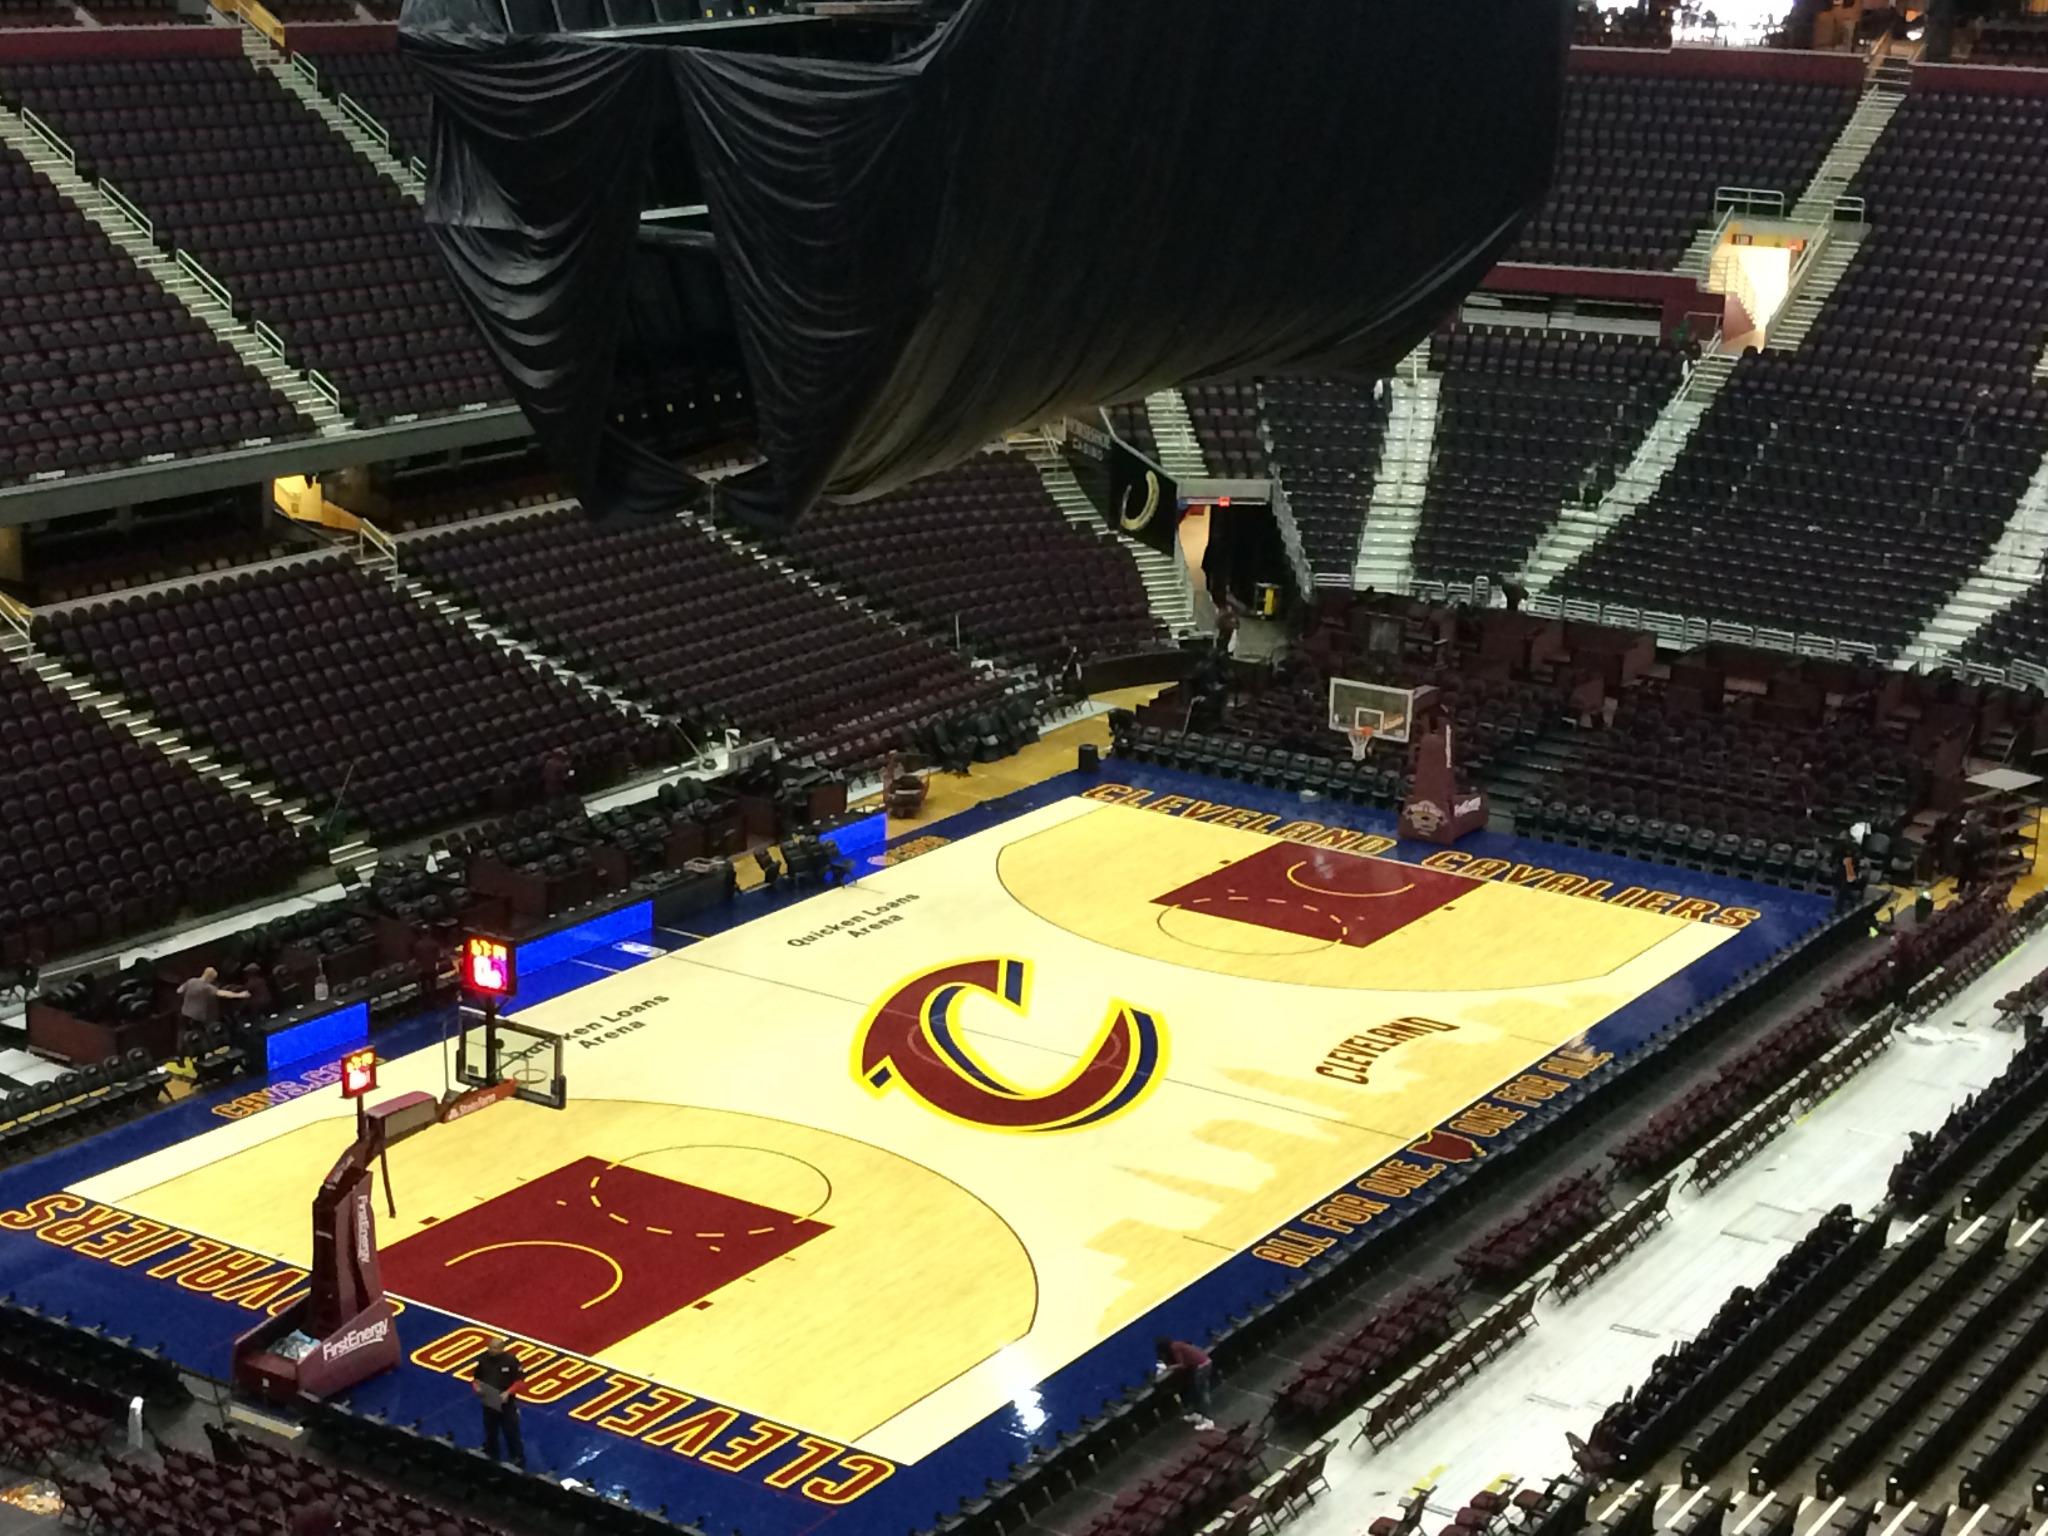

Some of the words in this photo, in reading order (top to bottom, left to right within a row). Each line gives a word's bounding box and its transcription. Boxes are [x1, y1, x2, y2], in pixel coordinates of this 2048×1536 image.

[1080, 783, 1397, 856] CLEVELAND
[1421, 850, 1761, 928] CAVALIERS
[787, 915, 866, 947] Quicken
[862, 893, 920, 916] Loans
[848, 913, 904, 938] Arena
[578, 1020, 646, 1049] Arena
[602, 994, 670, 1023] Loans
[1315, 1017, 1460, 1085] CLEVELAND
[1448, 1101, 1527, 1137] ONE
[1493, 1074, 1571, 1108] FOR
[1252, 1229, 1338, 1267] ALL
[1301, 1193, 1390, 1234] FOR
[322, 1318, 389, 1361] FirstEnergy
